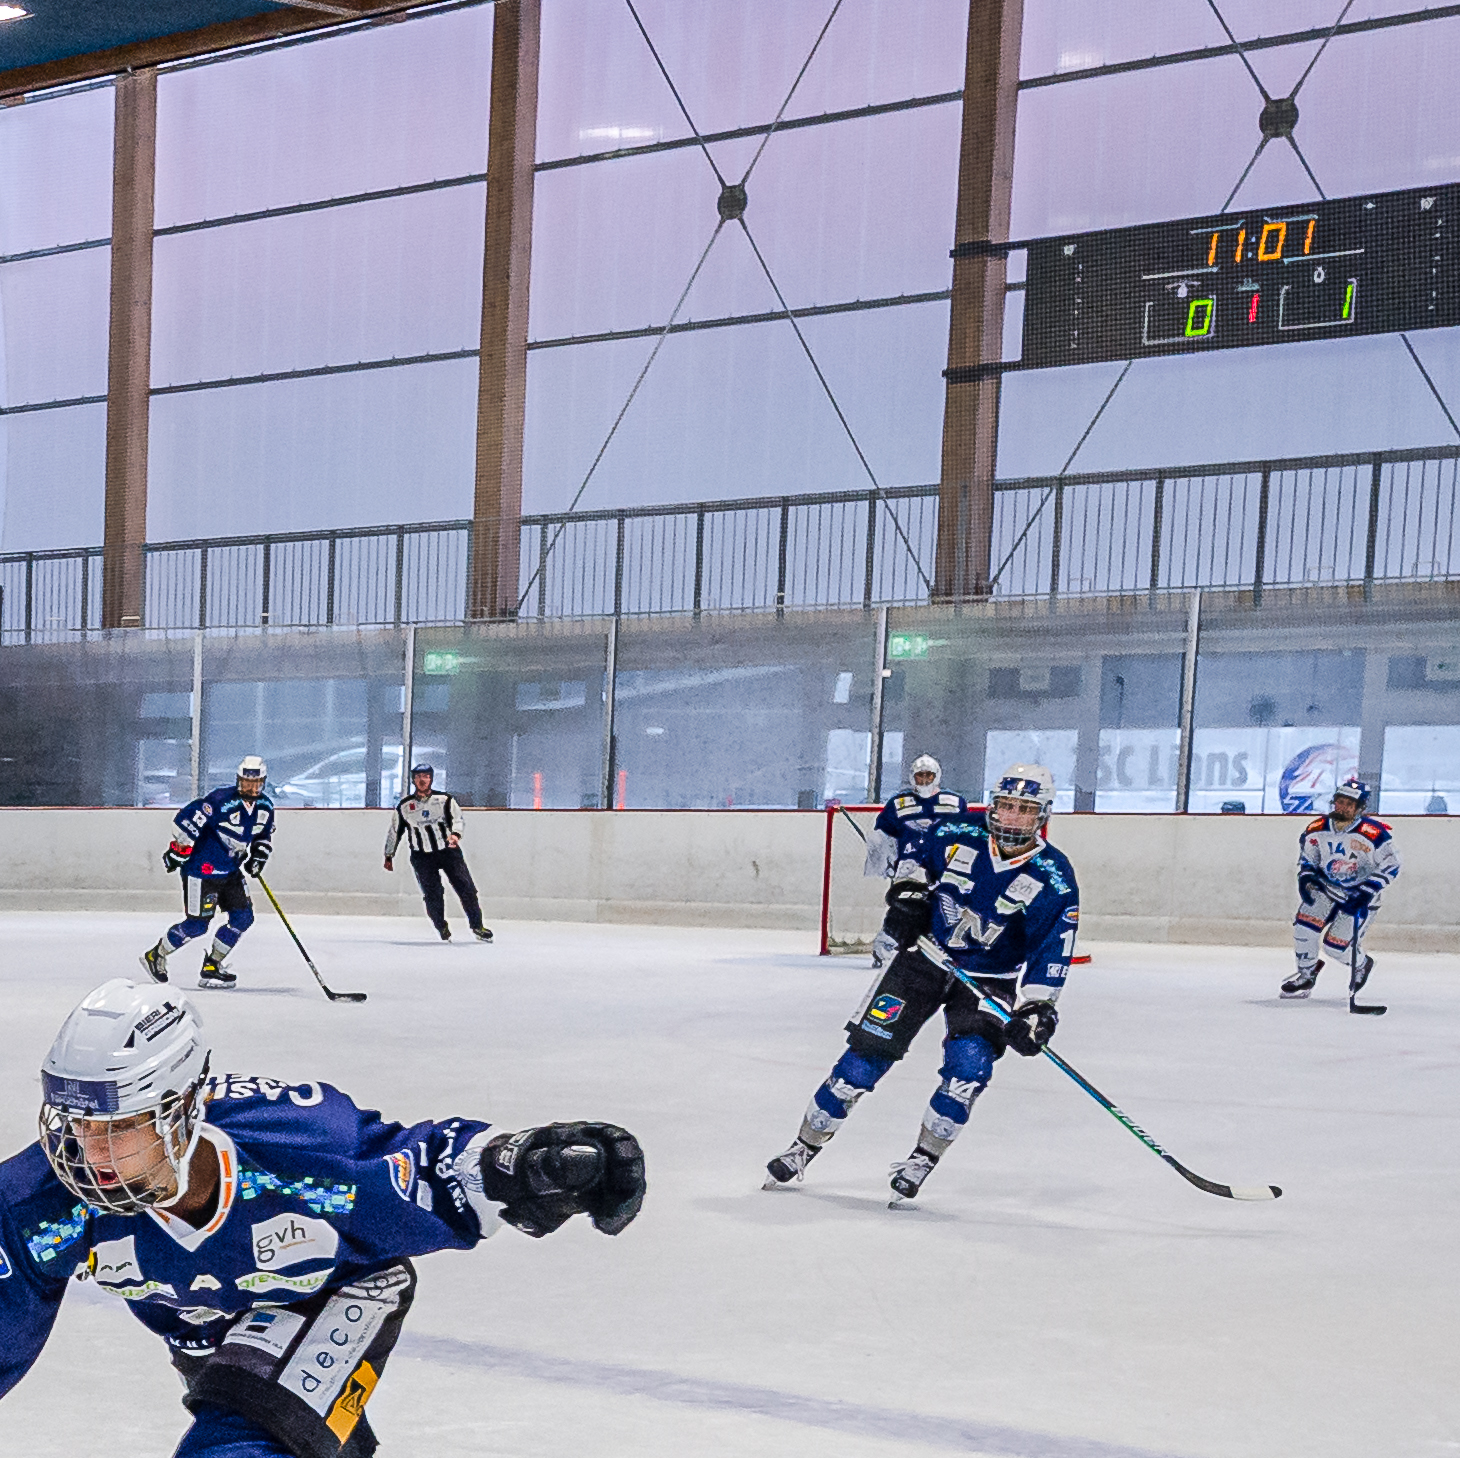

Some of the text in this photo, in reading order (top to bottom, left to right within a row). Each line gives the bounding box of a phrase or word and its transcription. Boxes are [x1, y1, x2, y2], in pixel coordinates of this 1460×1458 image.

[1208, 220, 1316, 266] 11:01
[1185, 300, 1213, 337] 0
[1343, 284, 1353, 319] 1
[1327, 841, 1346, 856] 14
[134, 1008, 162, 1031] BIERI
[256, 1220, 307, 1264] gvh
[300, 1304, 363, 1393] deco
